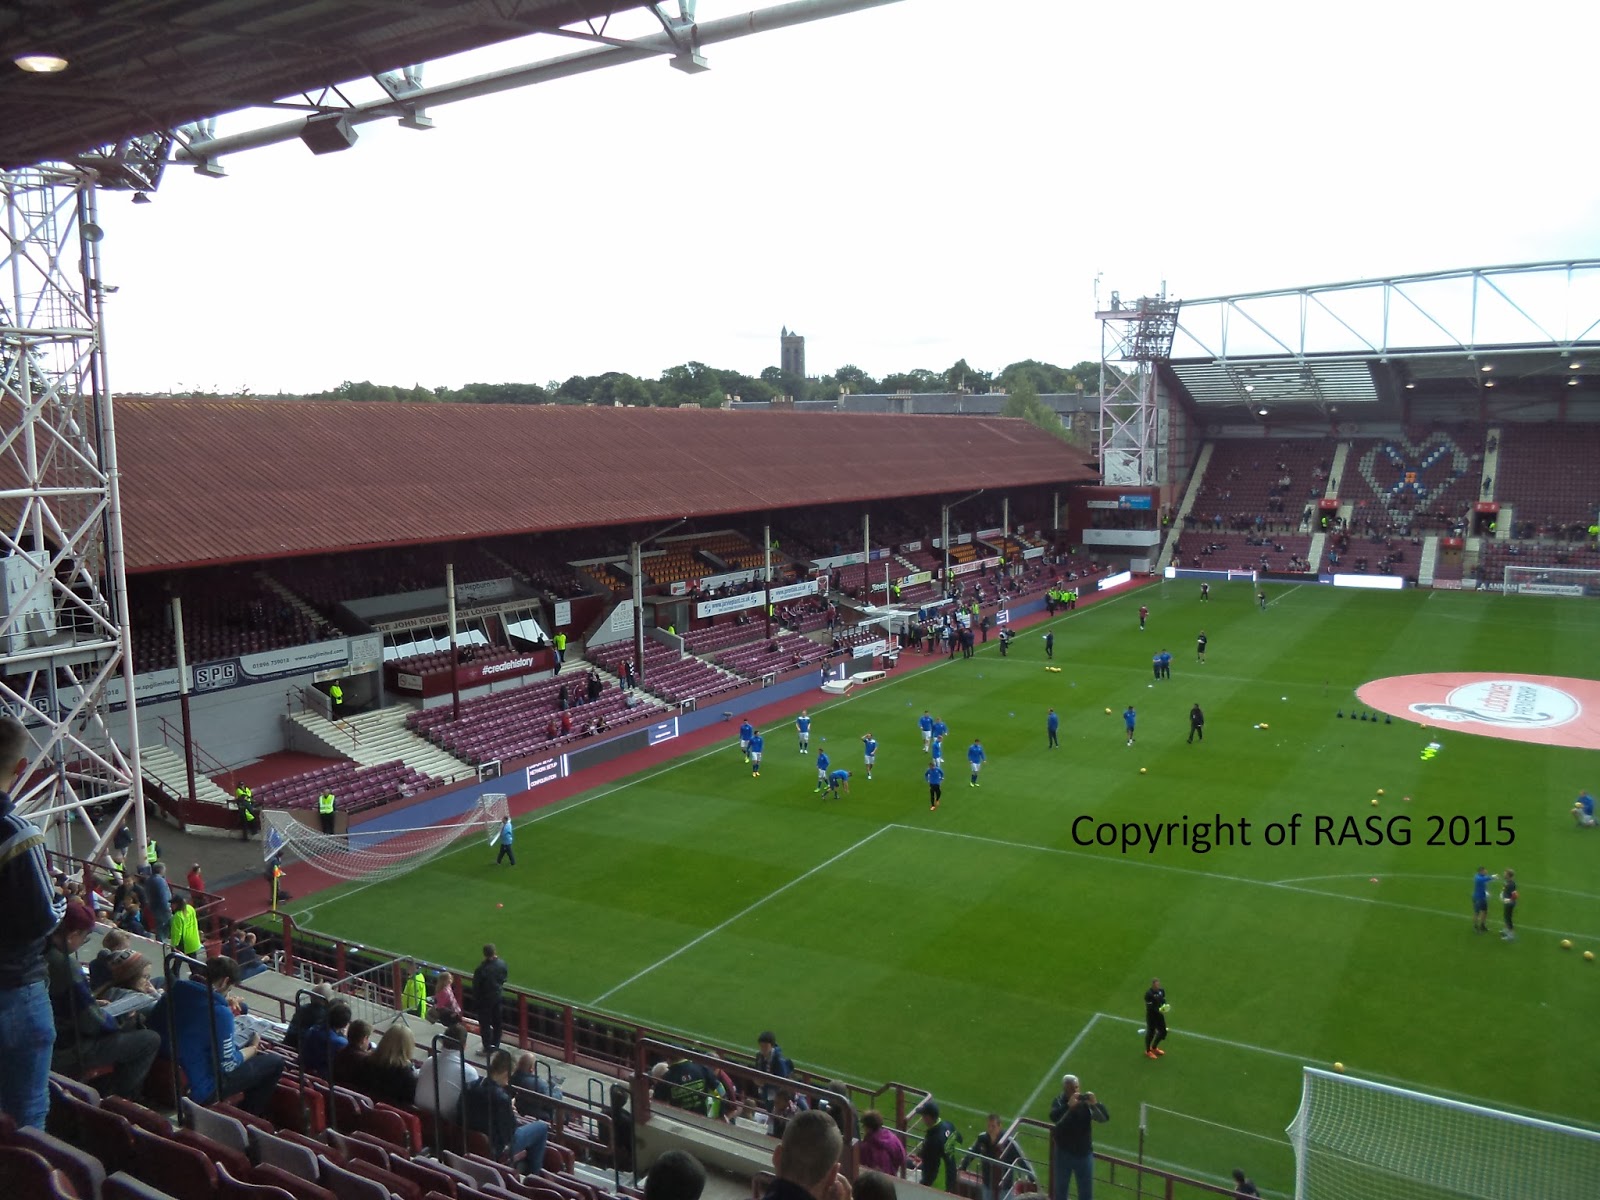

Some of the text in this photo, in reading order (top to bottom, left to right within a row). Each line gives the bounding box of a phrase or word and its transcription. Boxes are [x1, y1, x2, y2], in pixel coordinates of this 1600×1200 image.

[393, 620, 417, 629] JOHN
[420, 611, 470, 625] ROBERON
[471, 603, 502, 616] LOUNGE
[197, 664, 235, 682] SPG
[482, 657, 534, 675] #createhistory
